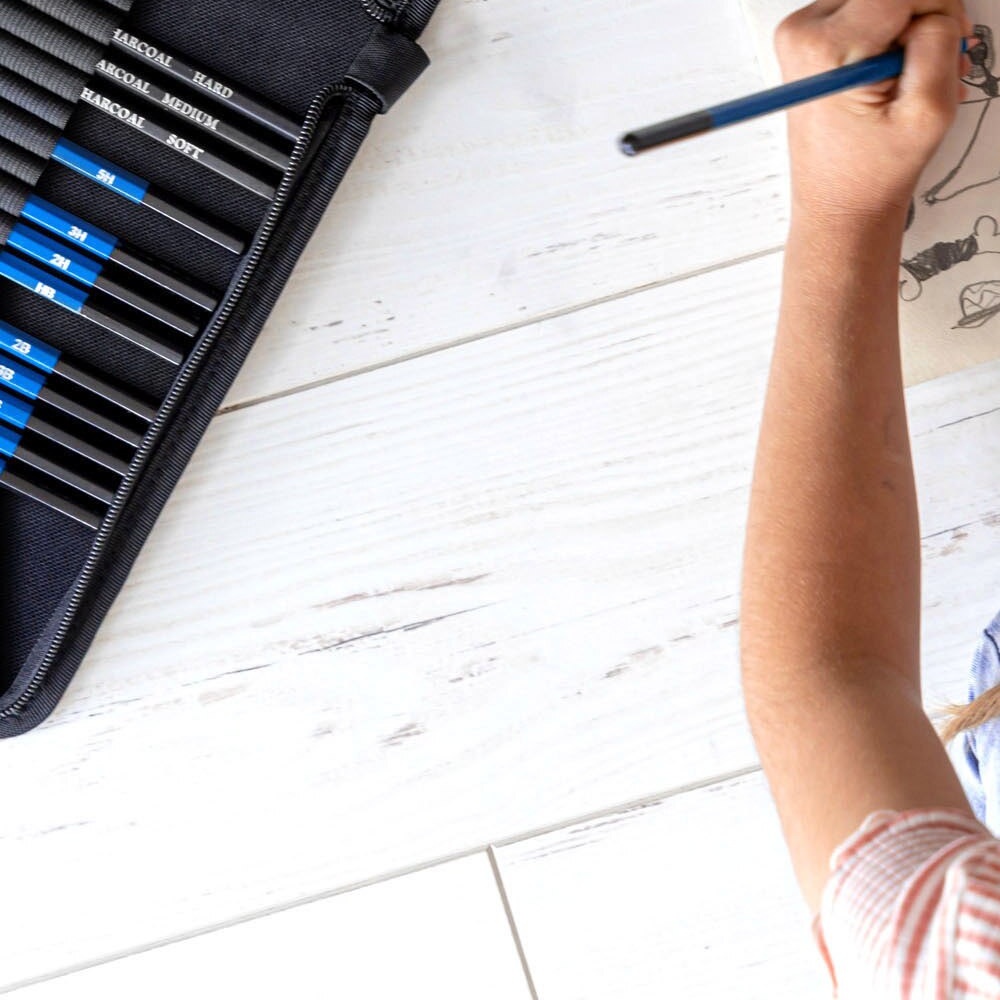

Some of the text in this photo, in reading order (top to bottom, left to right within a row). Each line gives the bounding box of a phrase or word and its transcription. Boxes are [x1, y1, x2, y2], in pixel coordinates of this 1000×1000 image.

[192, 71, 234, 99] HARD
[95, 59, 220, 130] ARCOAL MEDIUM
[79, 87, 204, 160] HARCOAL SOFT
[95, 169, 116, 185] 5H
[67, 225, 88, 242] 3H
[49, 253, 71, 270] 2H
[34, 282, 56, 299] HB
[10, 338, 31, 354] 2B
